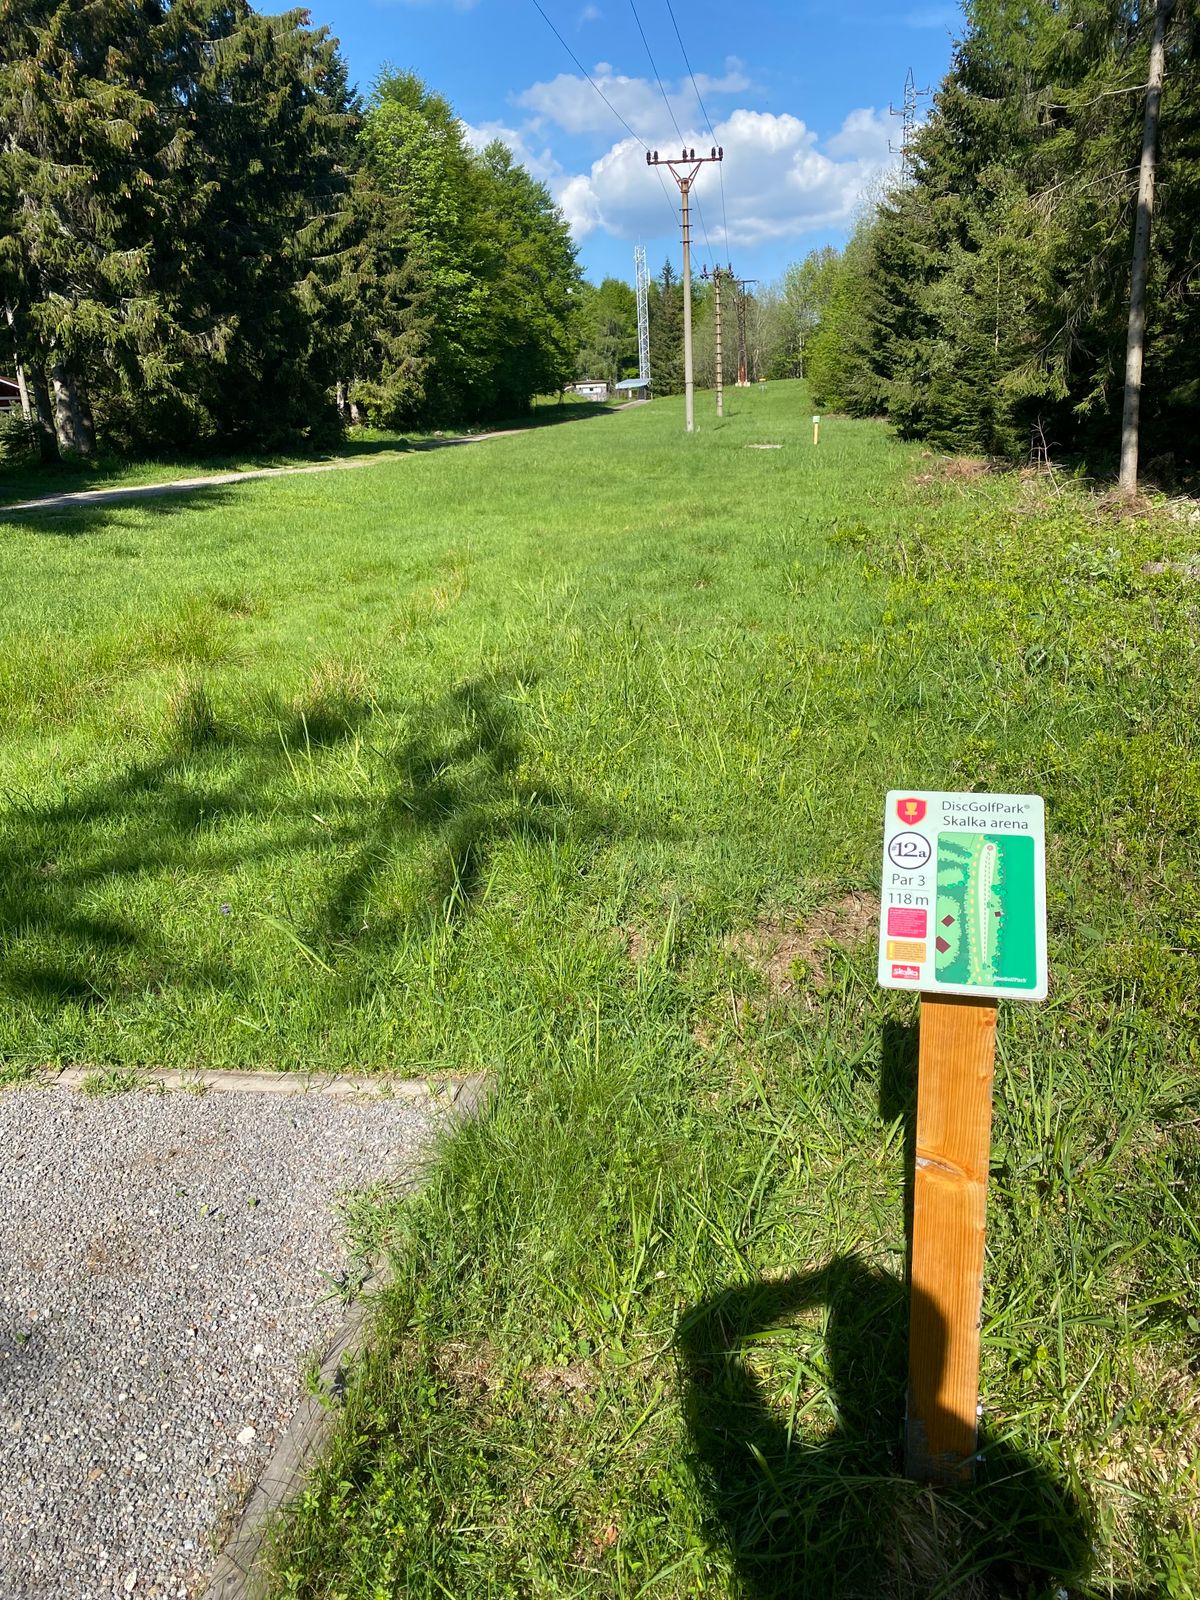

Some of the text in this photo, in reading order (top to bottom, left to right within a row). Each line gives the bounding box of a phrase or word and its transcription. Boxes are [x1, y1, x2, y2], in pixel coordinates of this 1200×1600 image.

[943, 816, 1028, 829] Skalka arena
[892, 873, 925, 886] Par 3
[889, 893, 929, 905] 118 m
